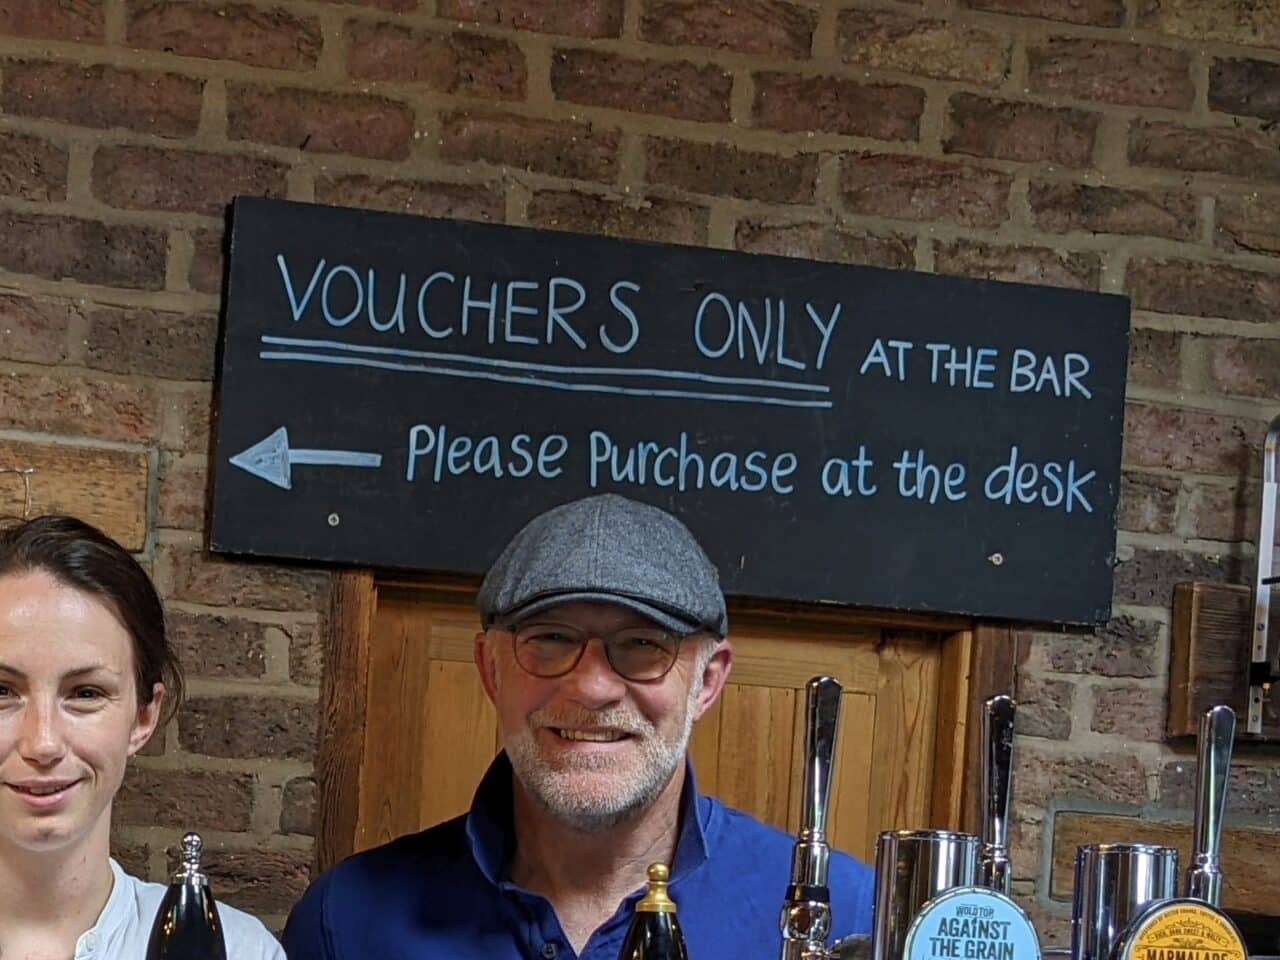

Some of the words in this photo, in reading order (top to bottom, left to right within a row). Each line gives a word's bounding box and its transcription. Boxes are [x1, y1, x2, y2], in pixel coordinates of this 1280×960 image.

[277, 254, 640, 353] VOUCHERS
[695, 292, 841, 370] ONLY
[860, 338, 912, 381] AT
[926, 343, 998, 389] THE
[1010, 349, 1091, 399] BAR
[407, 424, 568, 483] Please
[589, 432, 798, 494] Purchase
[822, 446, 877, 497] at
[893, 448, 966, 504] the
[984, 446, 1096, 512] desk
[929, 937, 961, 957] THE
[964, 940, 1014, 960] GRAIN
[937, 917, 1011, 940] AGAINST
